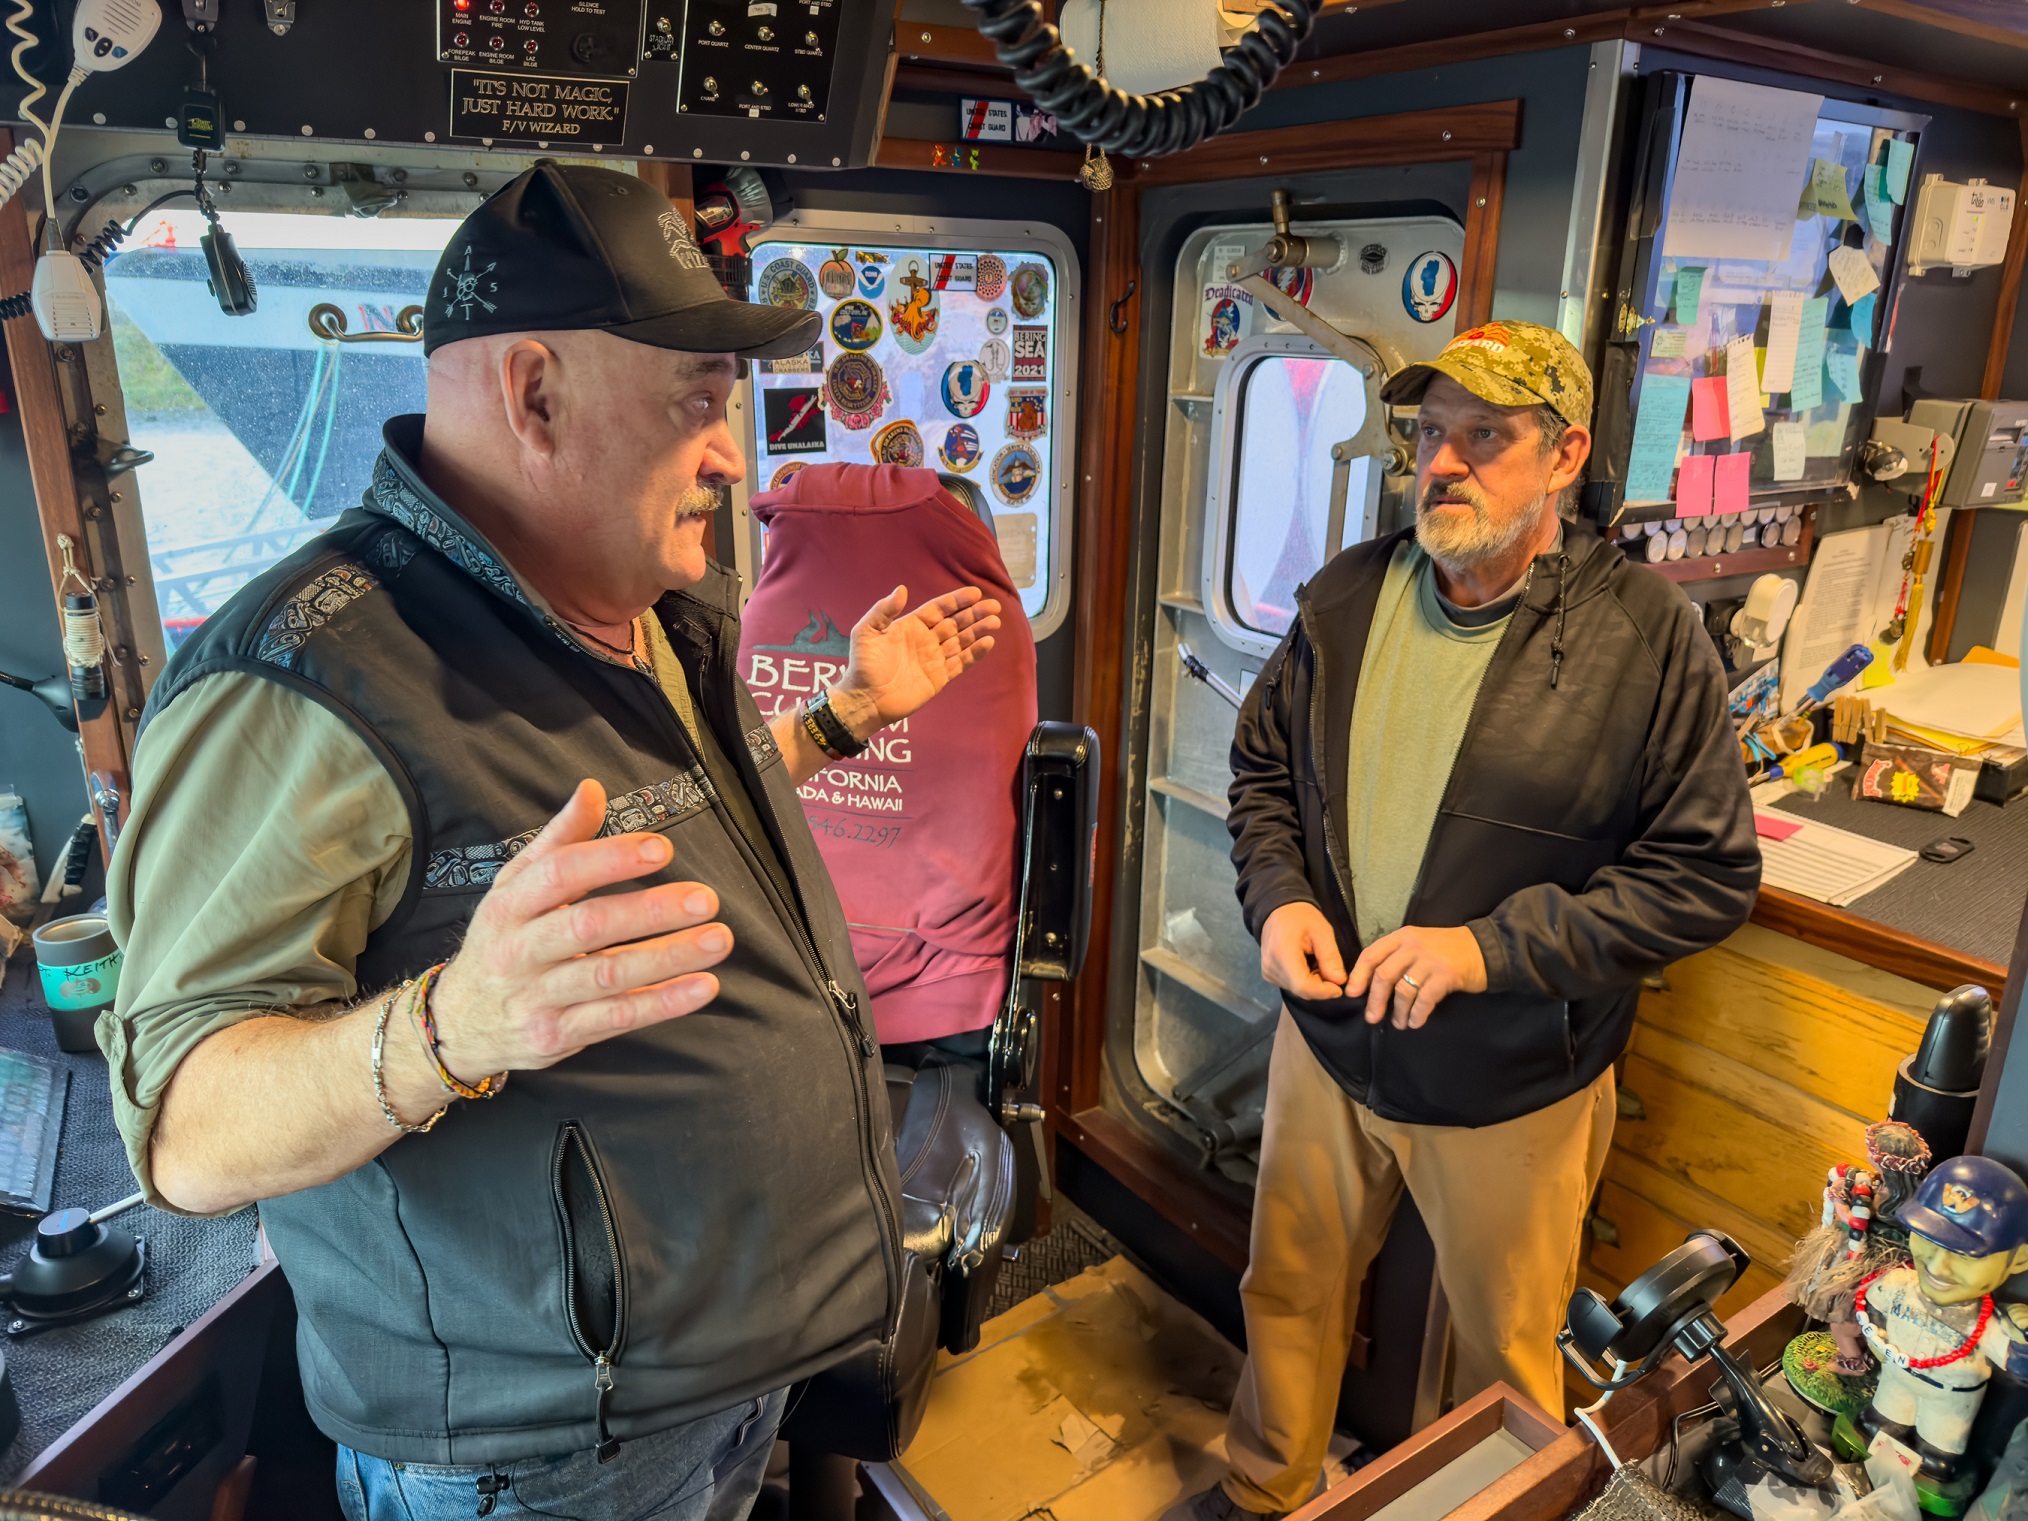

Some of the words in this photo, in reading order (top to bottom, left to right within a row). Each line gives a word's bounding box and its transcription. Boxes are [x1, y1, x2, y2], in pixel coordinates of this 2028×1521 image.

[452, 18, 472, 26] ENGINE
[479, 15, 499, 23] ENGINE
[499, 16, 516, 24] ROOM
[711, 40, 729, 48] QUARTZ
[478, 51, 498, 59] ENGINE
[498, 52, 515, 60] ROOM
[489, 57, 504, 65] BILGE
[512, 82, 549, 99] NOT
[554, 85, 613, 104] MAGIC,
[461, 97, 501, 115] JUST
[506, 100, 557, 118] HARD
[561, 104, 620, 121] WORK."
[966, 108, 985, 117] UNITED
[988, 108, 1008, 118] STATES
[502, 120, 527, 134] F/V
[530, 121, 581, 135] WIZARD
[988, 123, 1006, 132] GUARD
[770, 260, 793, 273] COAST
[795, 263, 815, 289] GUARD
[1015, 332, 1046, 341] BERING
[1014, 341, 1045, 358] SEA
[1014, 365, 1044, 375] 2021
[769, 442, 787, 451] DIVE
[787, 440, 825, 450] UNALASKA
[832, 791, 844, 804] &
[847, 793, 903, 811] HAWAII
